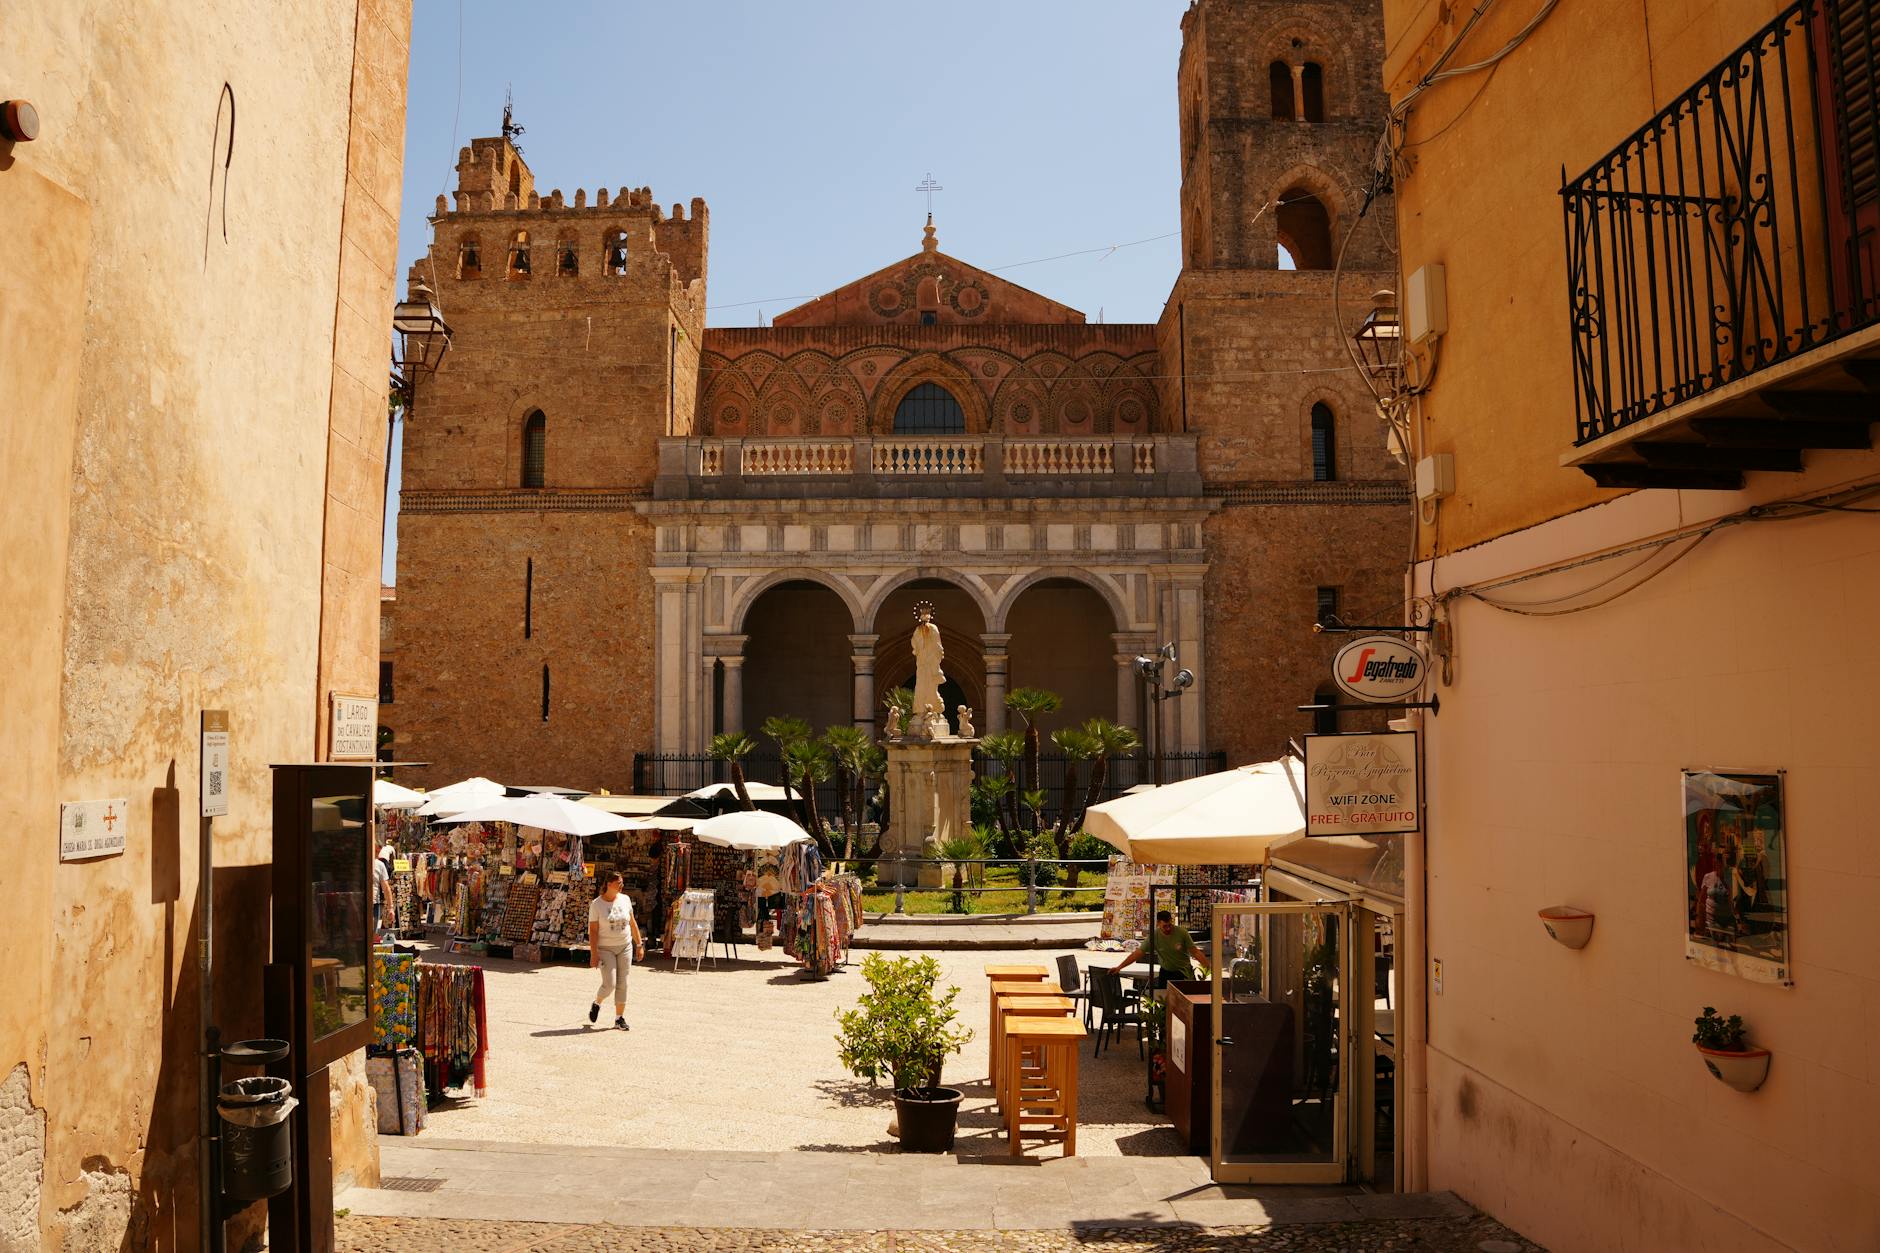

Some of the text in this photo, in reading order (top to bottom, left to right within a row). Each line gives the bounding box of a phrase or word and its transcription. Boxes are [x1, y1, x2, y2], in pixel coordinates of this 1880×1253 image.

[1347, 648, 1417, 683] Segafredo
[347, 704, 368, 720] LARGO
[1311, 760, 1411, 781] Pizzeria Guglielmo
[1330, 794, 1396, 806] WIFI ZONE
[1311, 814, 1341, 825] FREE
[1350, 811, 1415, 824] GRATUITO
